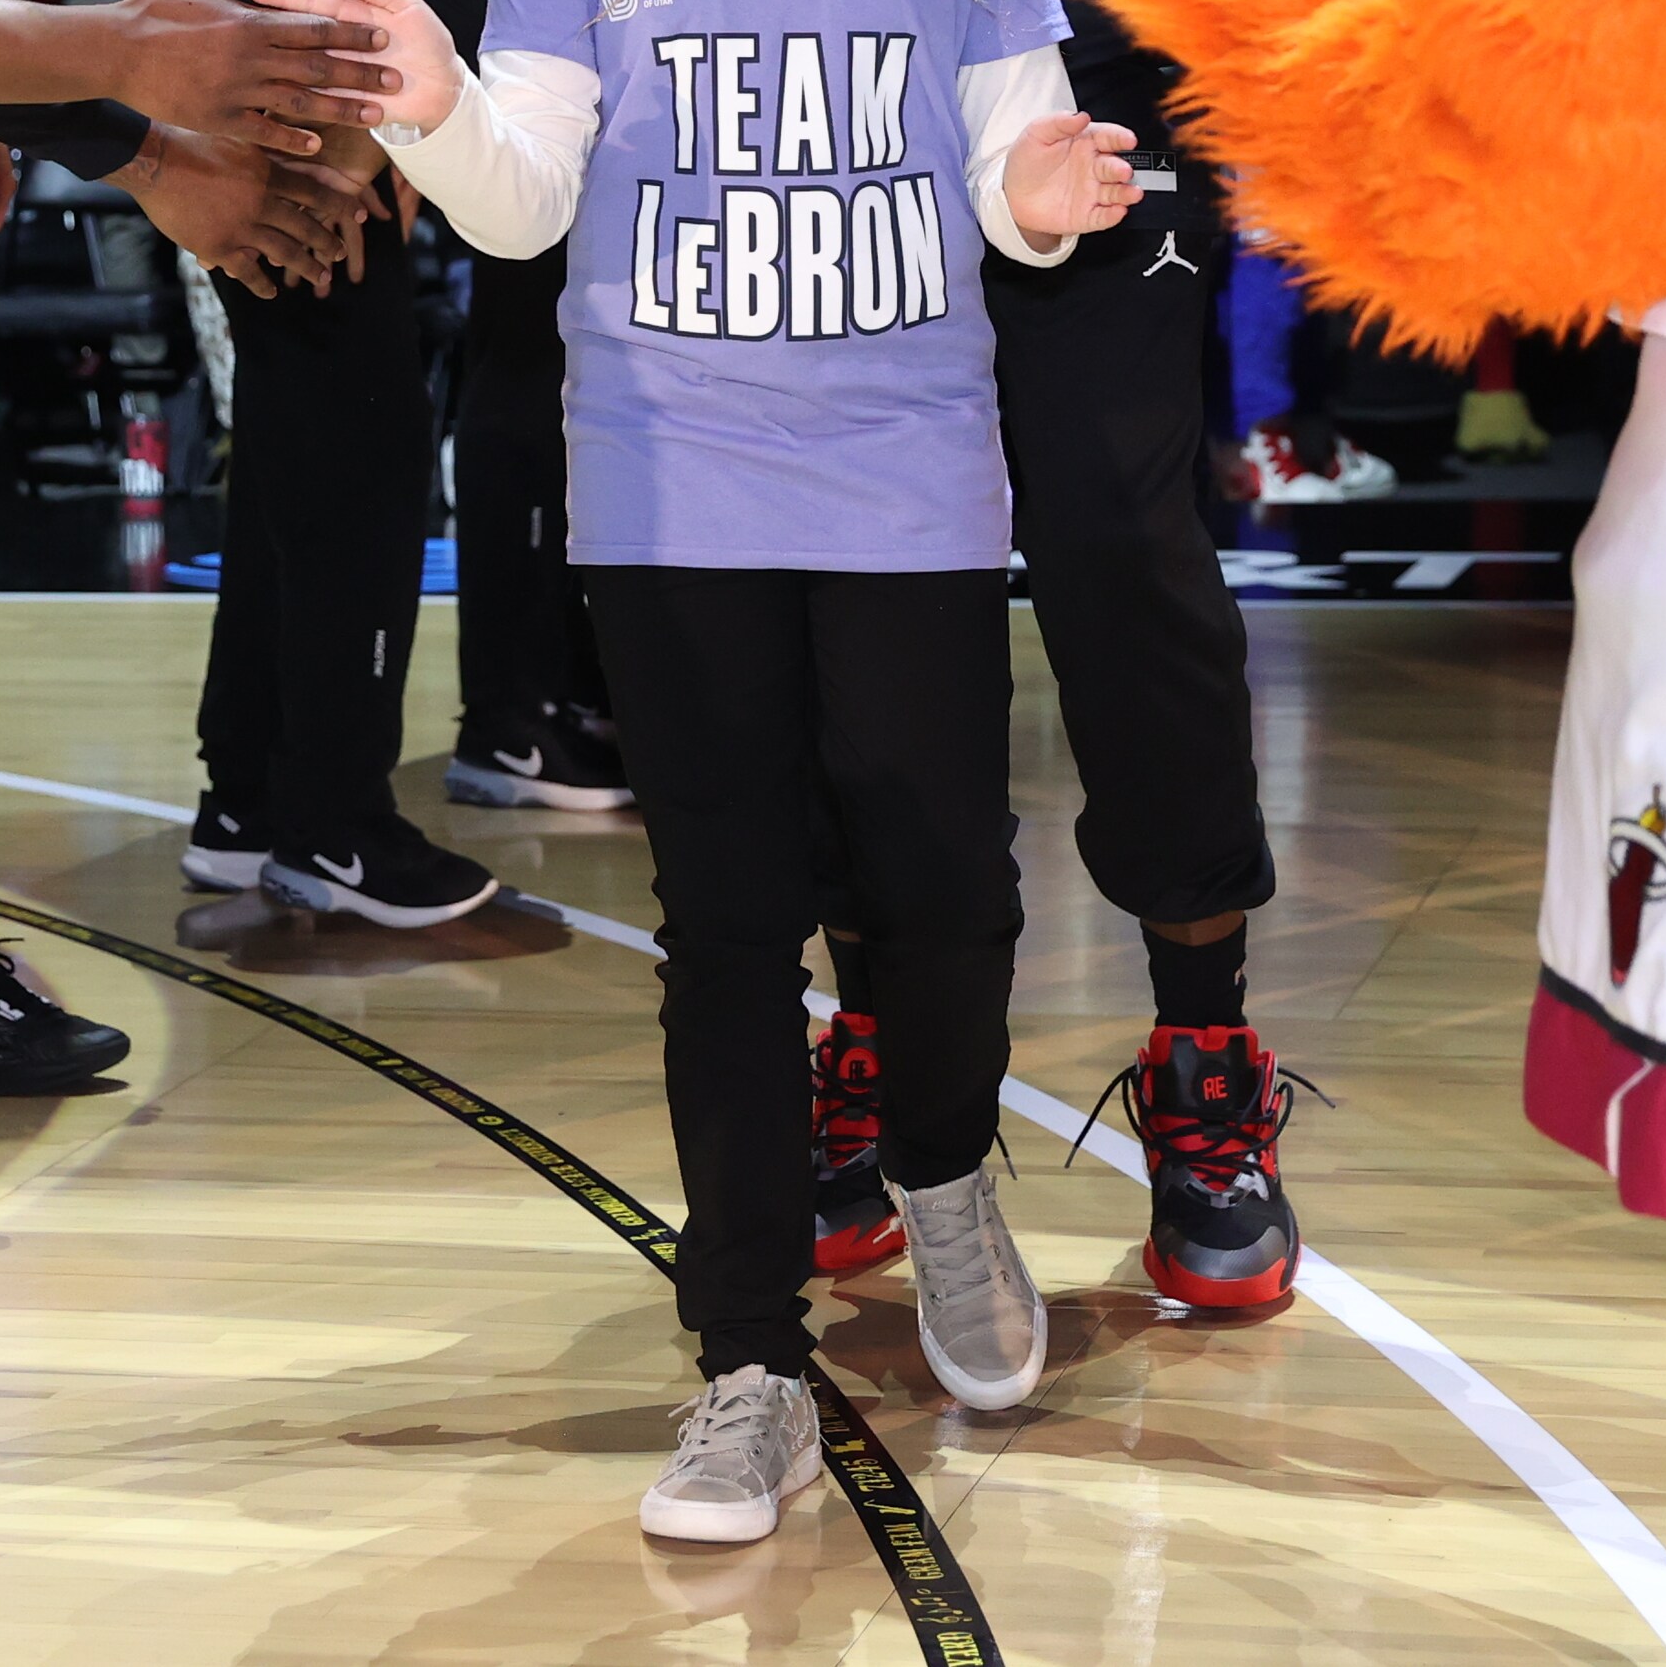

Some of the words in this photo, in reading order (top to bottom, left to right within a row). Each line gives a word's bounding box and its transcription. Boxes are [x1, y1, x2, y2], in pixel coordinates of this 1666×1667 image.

[643, 0, 653, 9] OF
[651, 31, 917, 176] TEAM
[1203, 1075, 1229, 1101] AE
